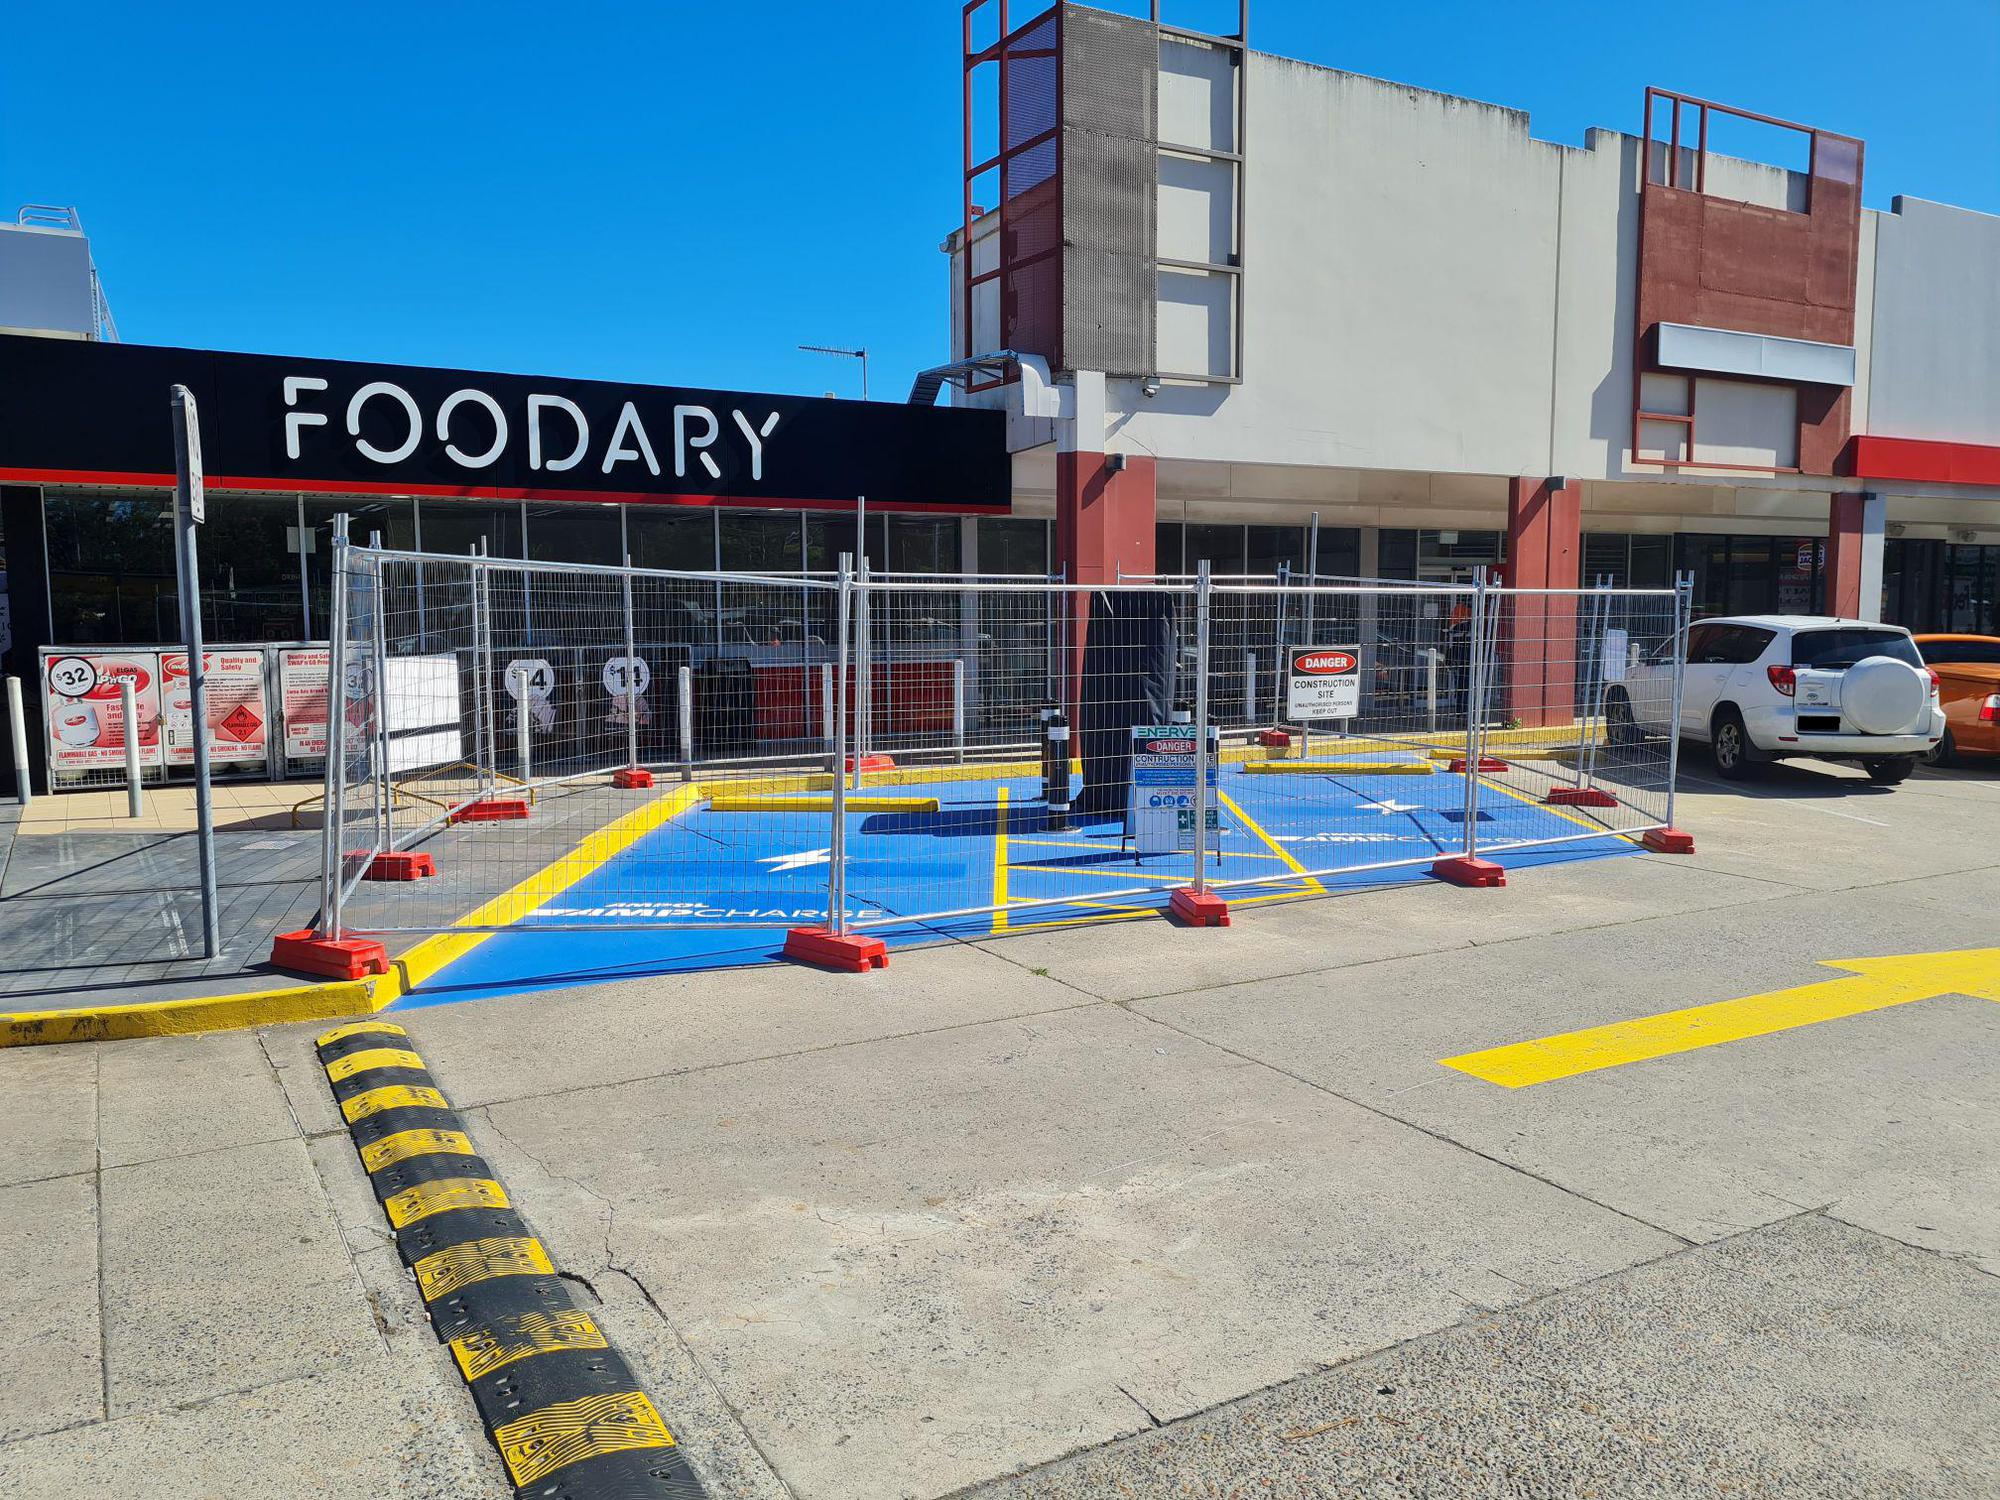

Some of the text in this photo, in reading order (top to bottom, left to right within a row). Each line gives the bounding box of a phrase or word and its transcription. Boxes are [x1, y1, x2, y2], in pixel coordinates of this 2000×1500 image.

[283, 376, 780, 481] FOODARY
[1305, 657, 1348, 669] DANGER
[56, 667, 88, 685] $32
[1294, 679, 1355, 689] CONSTRUCTION
[1317, 690, 1334, 699] SITE
[1156, 742, 1192, 752] DANGER
[59, 750, 87, 759] FLAMMABLE
[87, 749, 97, 757] GAS
[1136, 755, 1195, 763] CONTRUCTION
